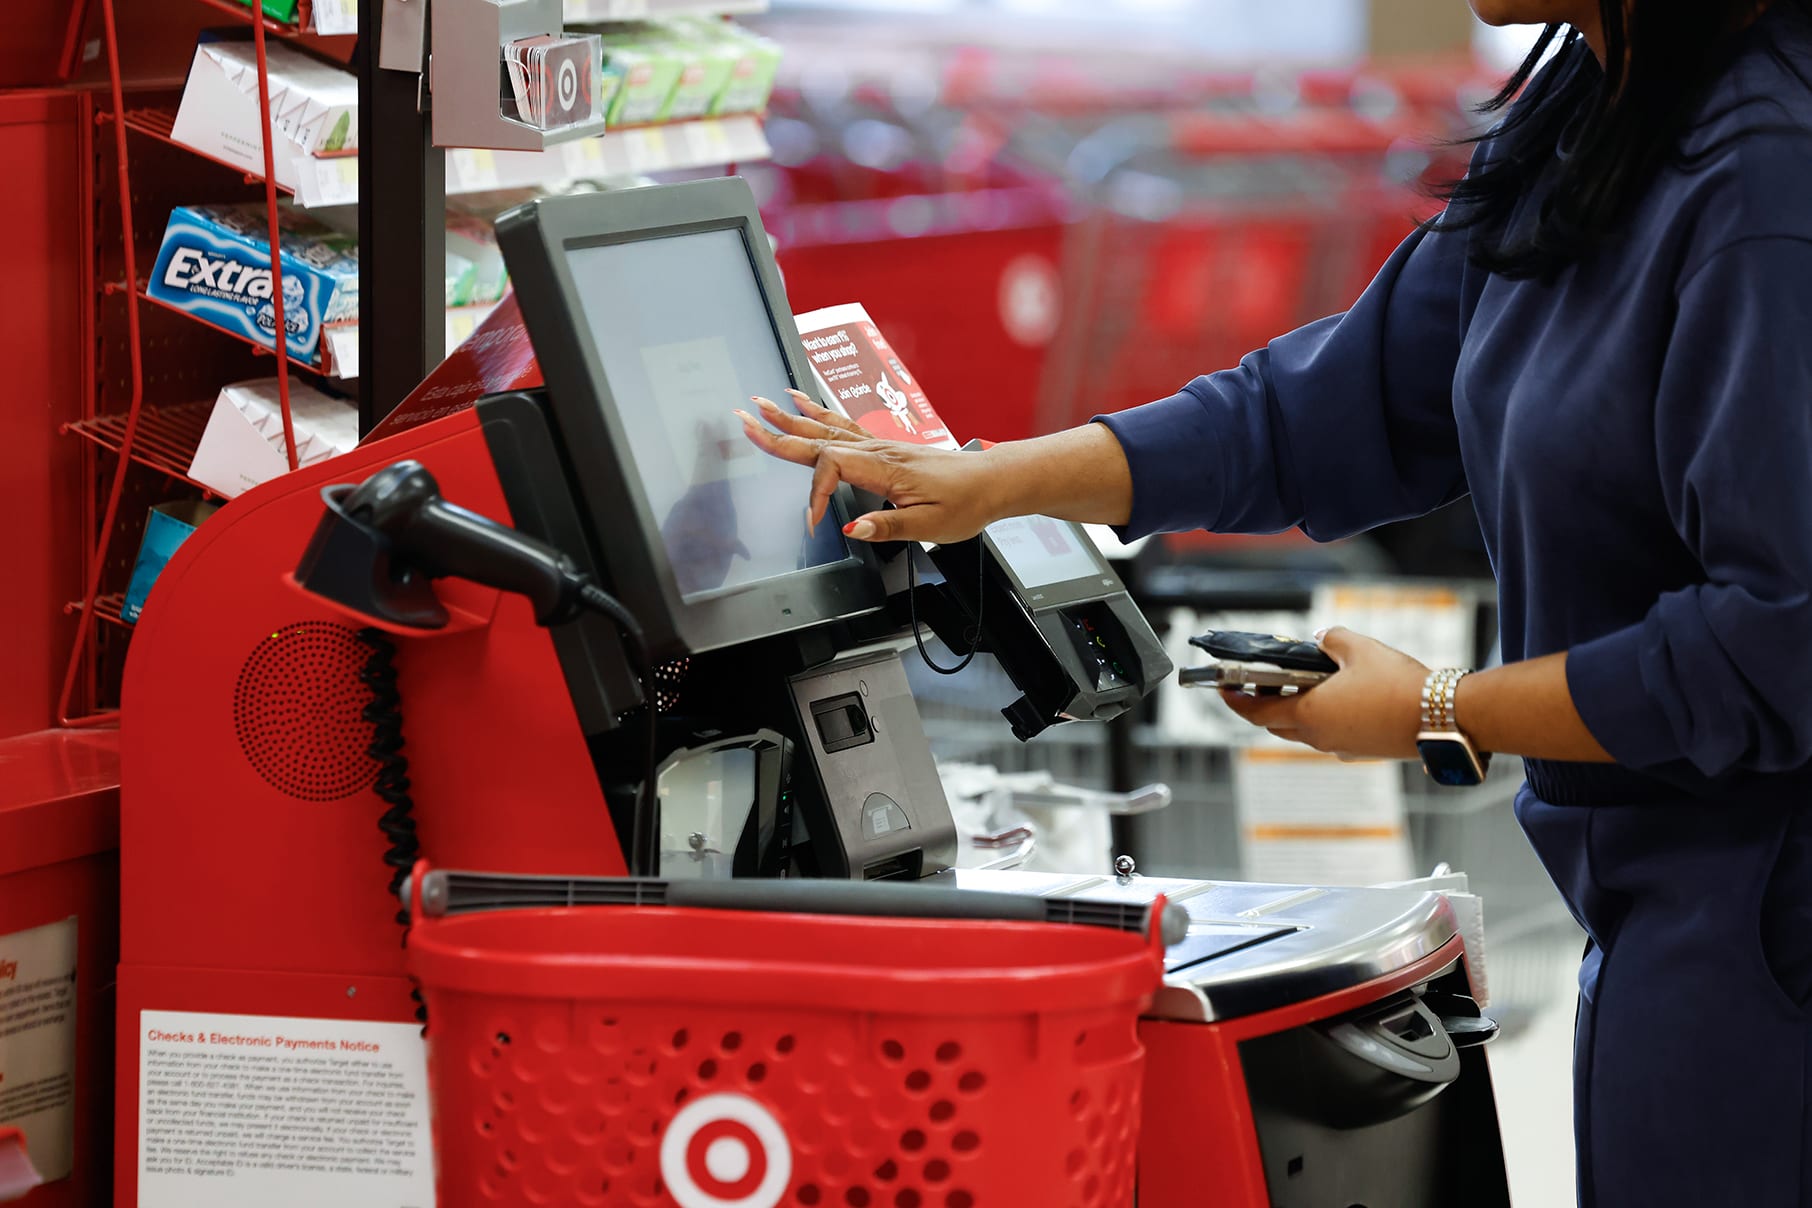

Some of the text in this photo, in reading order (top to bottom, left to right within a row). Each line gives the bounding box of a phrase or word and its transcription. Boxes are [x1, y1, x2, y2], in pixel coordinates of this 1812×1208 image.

[164, 246, 275, 304] Extra
[802, 336, 822, 351] Want
[826, 334, 841, 346] earn
[837, 330, 850, 342] 1%
[811, 342, 859, 364] when you shop?
[838, 388, 853, 400] Join
[149, 1030, 379, 1053] Checks & Electronic Payments Notice
